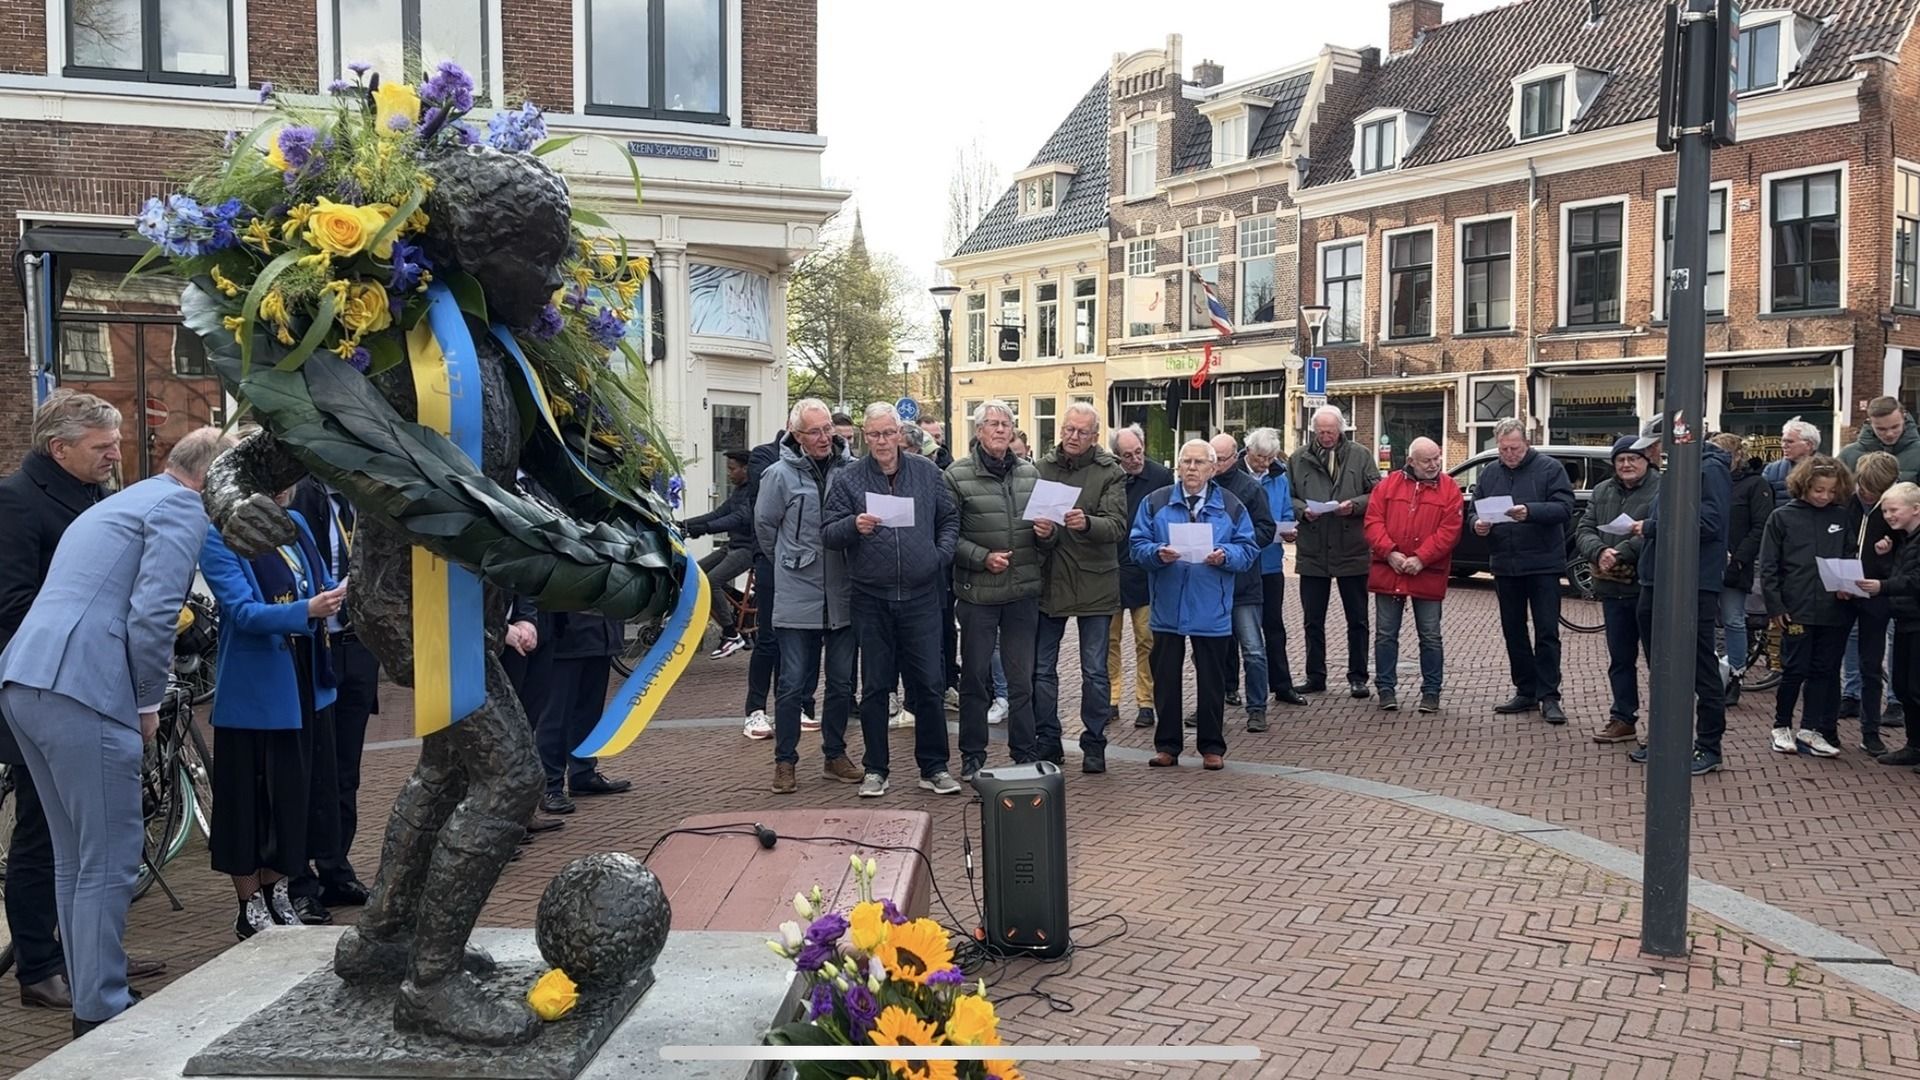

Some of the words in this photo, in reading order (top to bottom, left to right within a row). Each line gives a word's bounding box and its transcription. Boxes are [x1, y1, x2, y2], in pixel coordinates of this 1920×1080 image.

[630, 143, 653, 153] KLEIN
[655, 144, 705, 157] SCHAVERNEK
[1165, 356, 1186, 370] thai
[1187, 355, 1200, 370] by
[1743, 379, 1816, 399] HAIRCUTS
[1015, 851, 1034, 884] JBL
